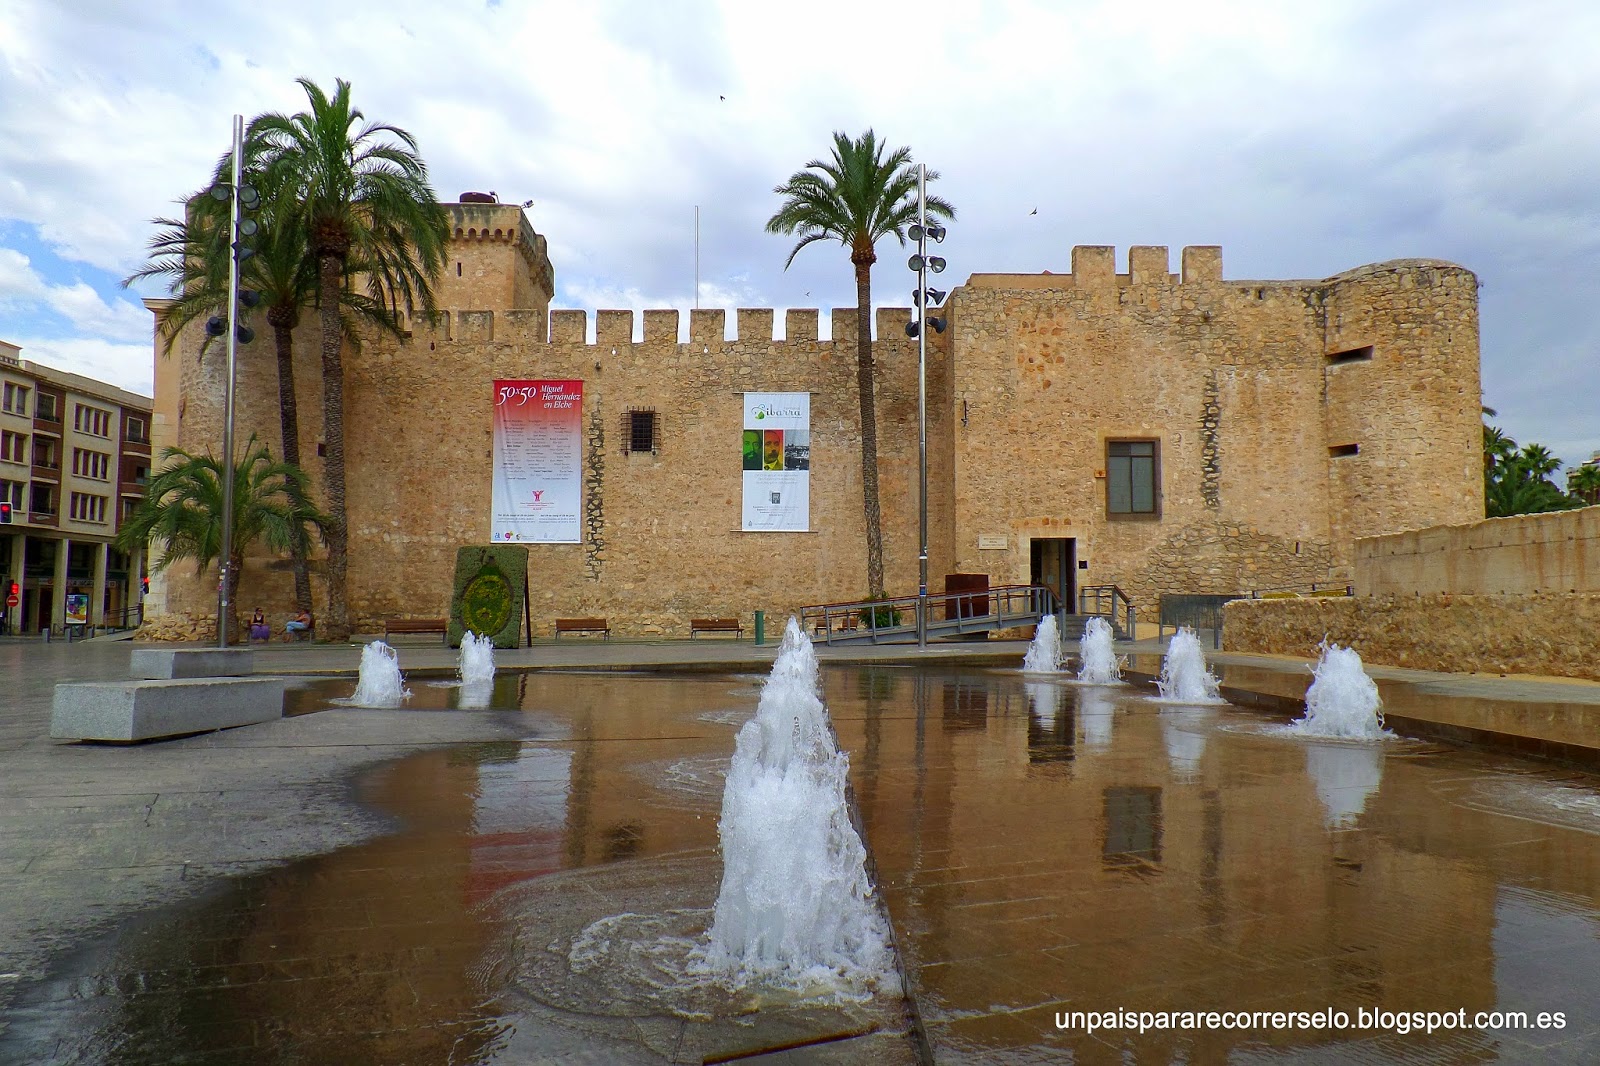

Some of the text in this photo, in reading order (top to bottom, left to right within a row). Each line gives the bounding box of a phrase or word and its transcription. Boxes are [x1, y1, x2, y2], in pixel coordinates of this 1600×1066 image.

[540, 385, 564, 394] Miguel
[495, 386, 537, 406] 50x50
[541, 392, 581, 401] Hernández
[553, 401, 573, 409] Elche
